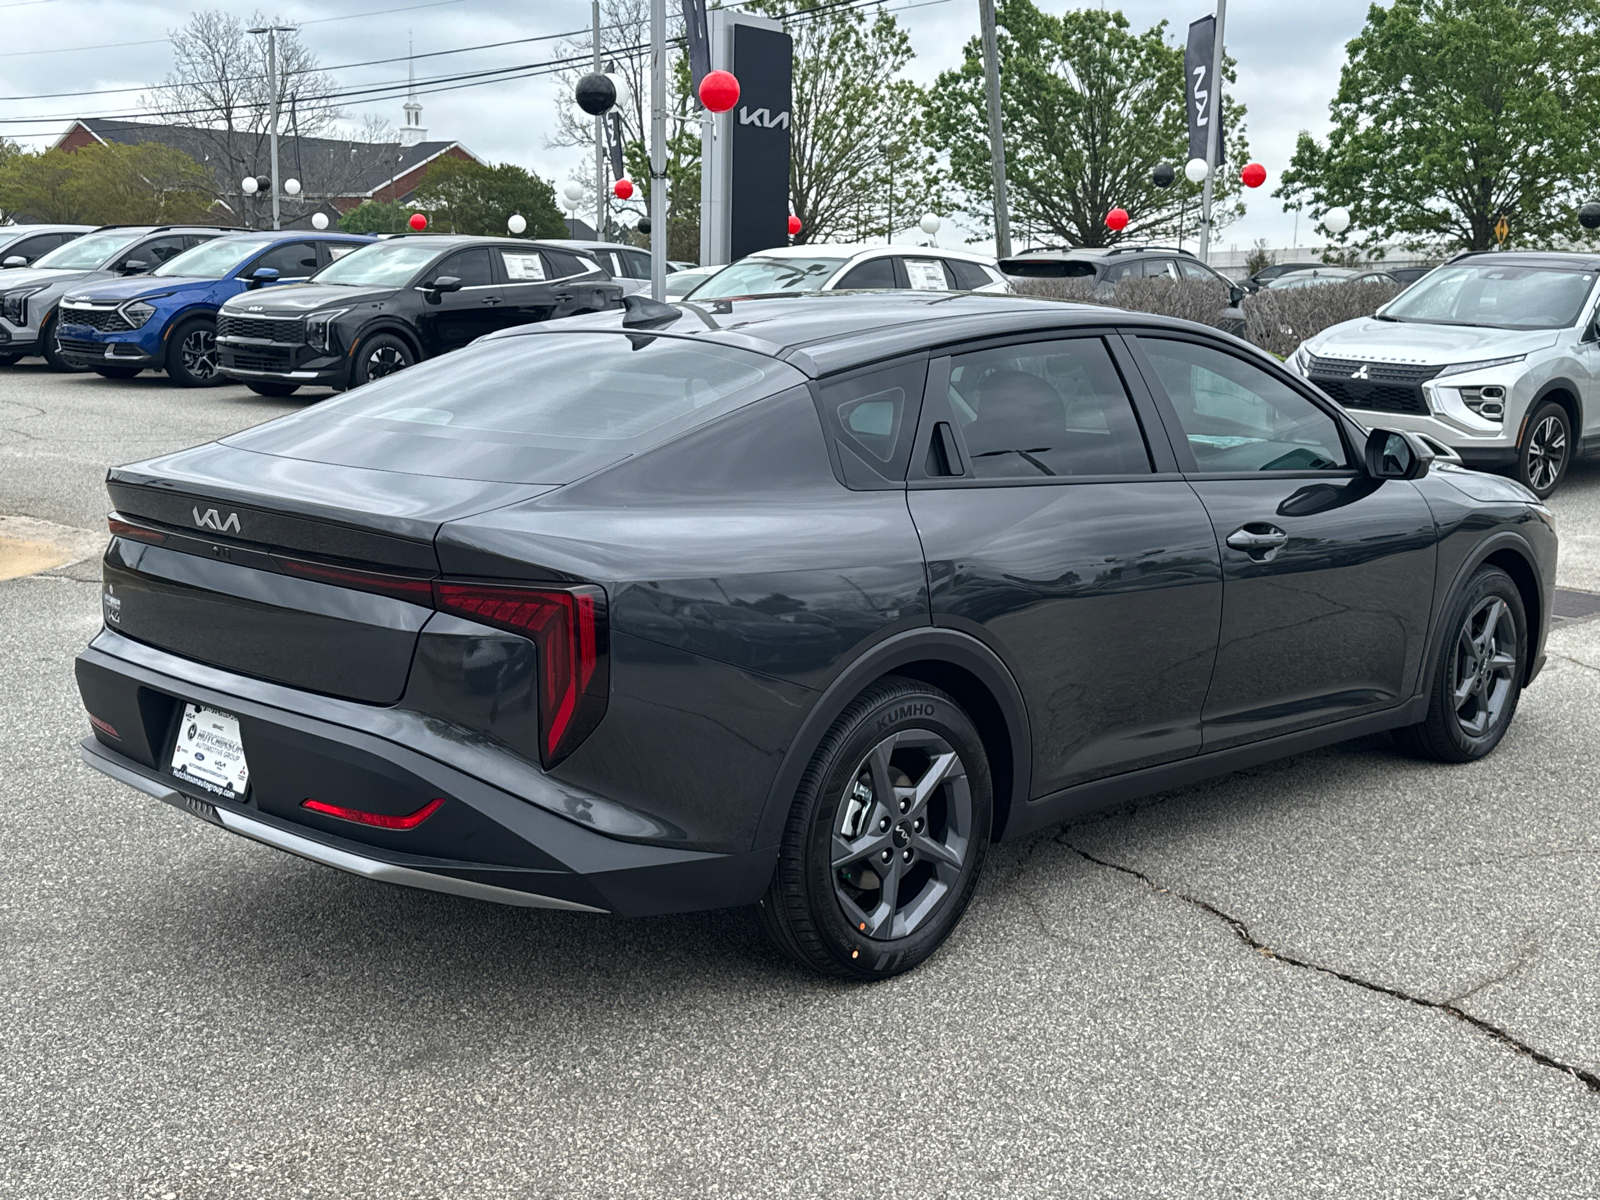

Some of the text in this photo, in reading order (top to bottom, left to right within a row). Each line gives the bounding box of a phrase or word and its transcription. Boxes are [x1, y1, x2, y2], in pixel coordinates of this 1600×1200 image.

[739, 105, 790, 130] KIA
[192, 505, 242, 533] KIA
[108, 608, 120, 623] K4
[876, 702, 935, 731] KUMHO
[195, 741, 223, 756] AUTOMOTIVE
[223, 751, 241, 762] GROUP
[196, 730, 243, 755] HUTCHINSON
